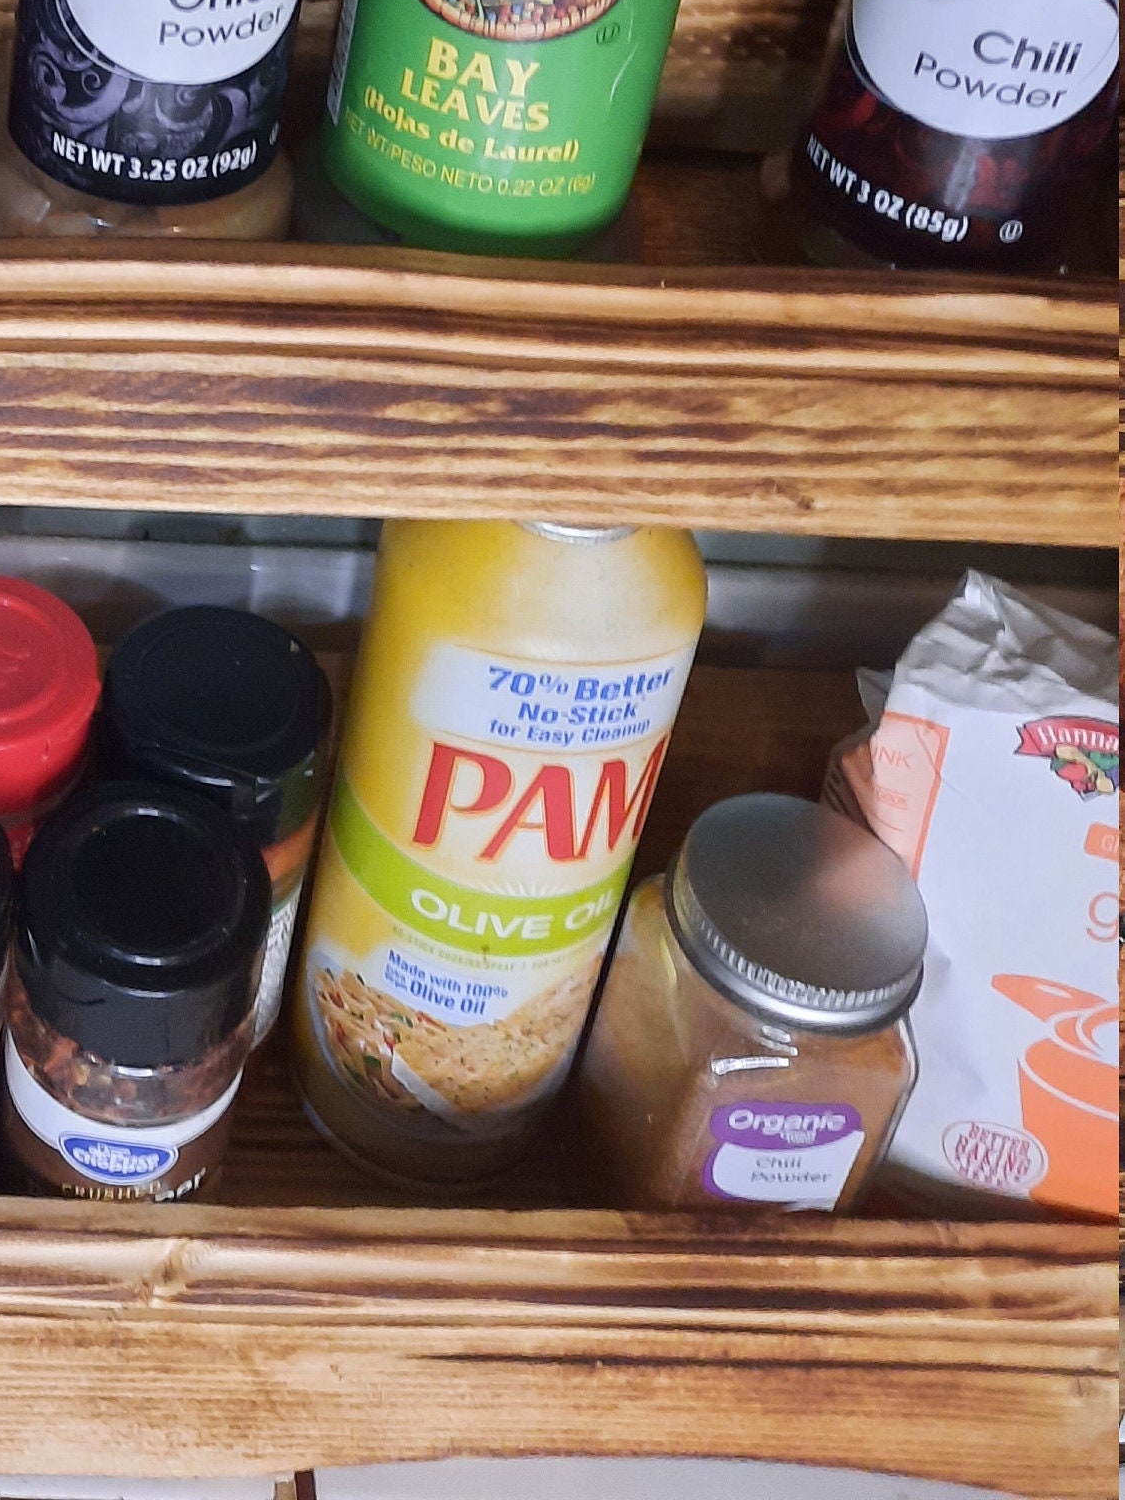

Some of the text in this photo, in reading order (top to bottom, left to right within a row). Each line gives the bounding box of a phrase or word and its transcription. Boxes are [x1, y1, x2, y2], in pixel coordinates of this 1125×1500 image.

[159, 4, 283, 47] Powder
[427, 37, 541, 97] BAY
[972, 30, 1083, 75] Chili
[400, 68, 550, 133] LEAVES
[913, 51, 1068, 109] Powder
[364, 85, 580, 163] (Hojas de Laurel)
[53, 131, 258, 181] NET WT 3.25 OZ (92g)
[440, 164, 493, 194] NETO
[806, 132, 970, 243] NET WT 3 OZ (85g)
[488, 665, 673, 700] 70% Better
[489, 719, 520, 739] for
[526, 726, 575, 748] Easy
[517, 701, 639, 725] No-Stick
[412, 730, 669, 863] PAM
[410, 887, 554, 940] OLIVE
[388, 948, 426, 980] Made
[429, 973, 462, 994] with
[465, 979, 510, 999] 100%
[409, 982, 488, 1016] Olive Oil
